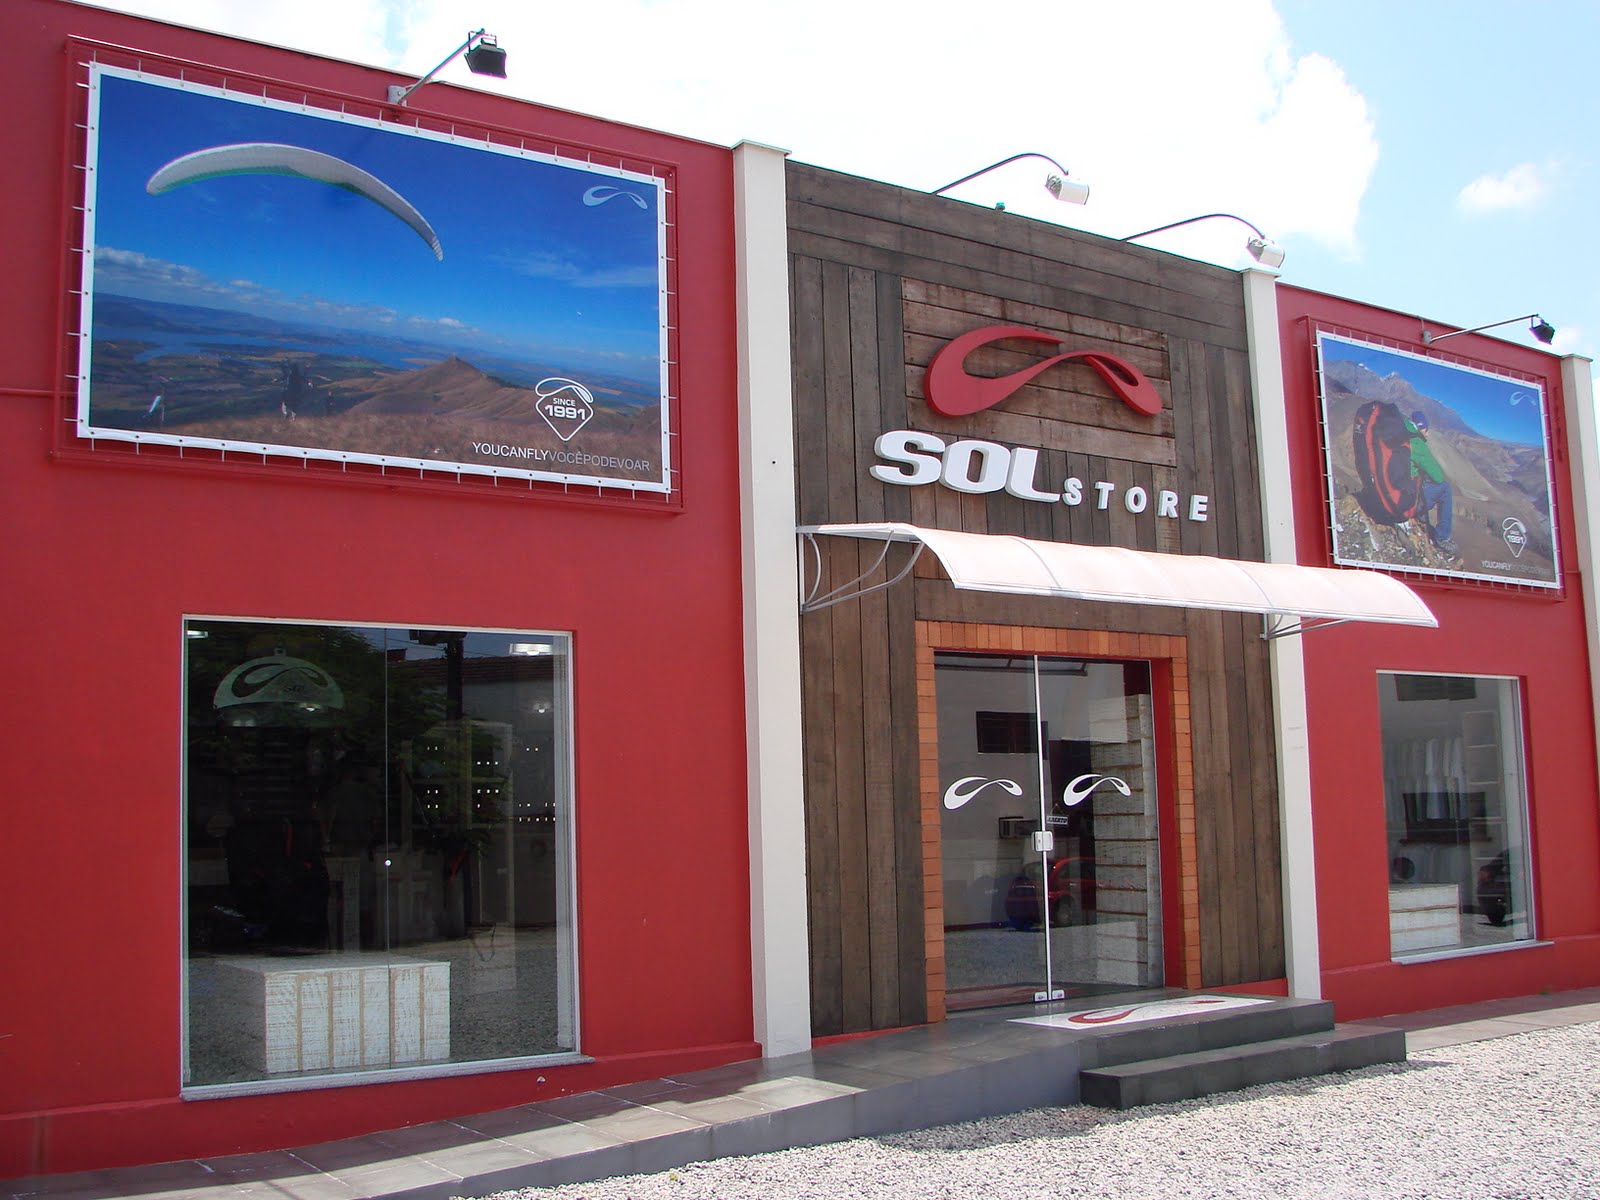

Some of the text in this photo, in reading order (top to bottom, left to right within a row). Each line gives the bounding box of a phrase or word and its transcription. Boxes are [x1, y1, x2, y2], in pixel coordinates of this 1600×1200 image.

[552, 397, 576, 407] SINCE
[544, 404, 586, 420] 1991
[869, 430, 1209, 522] SOL STORE
